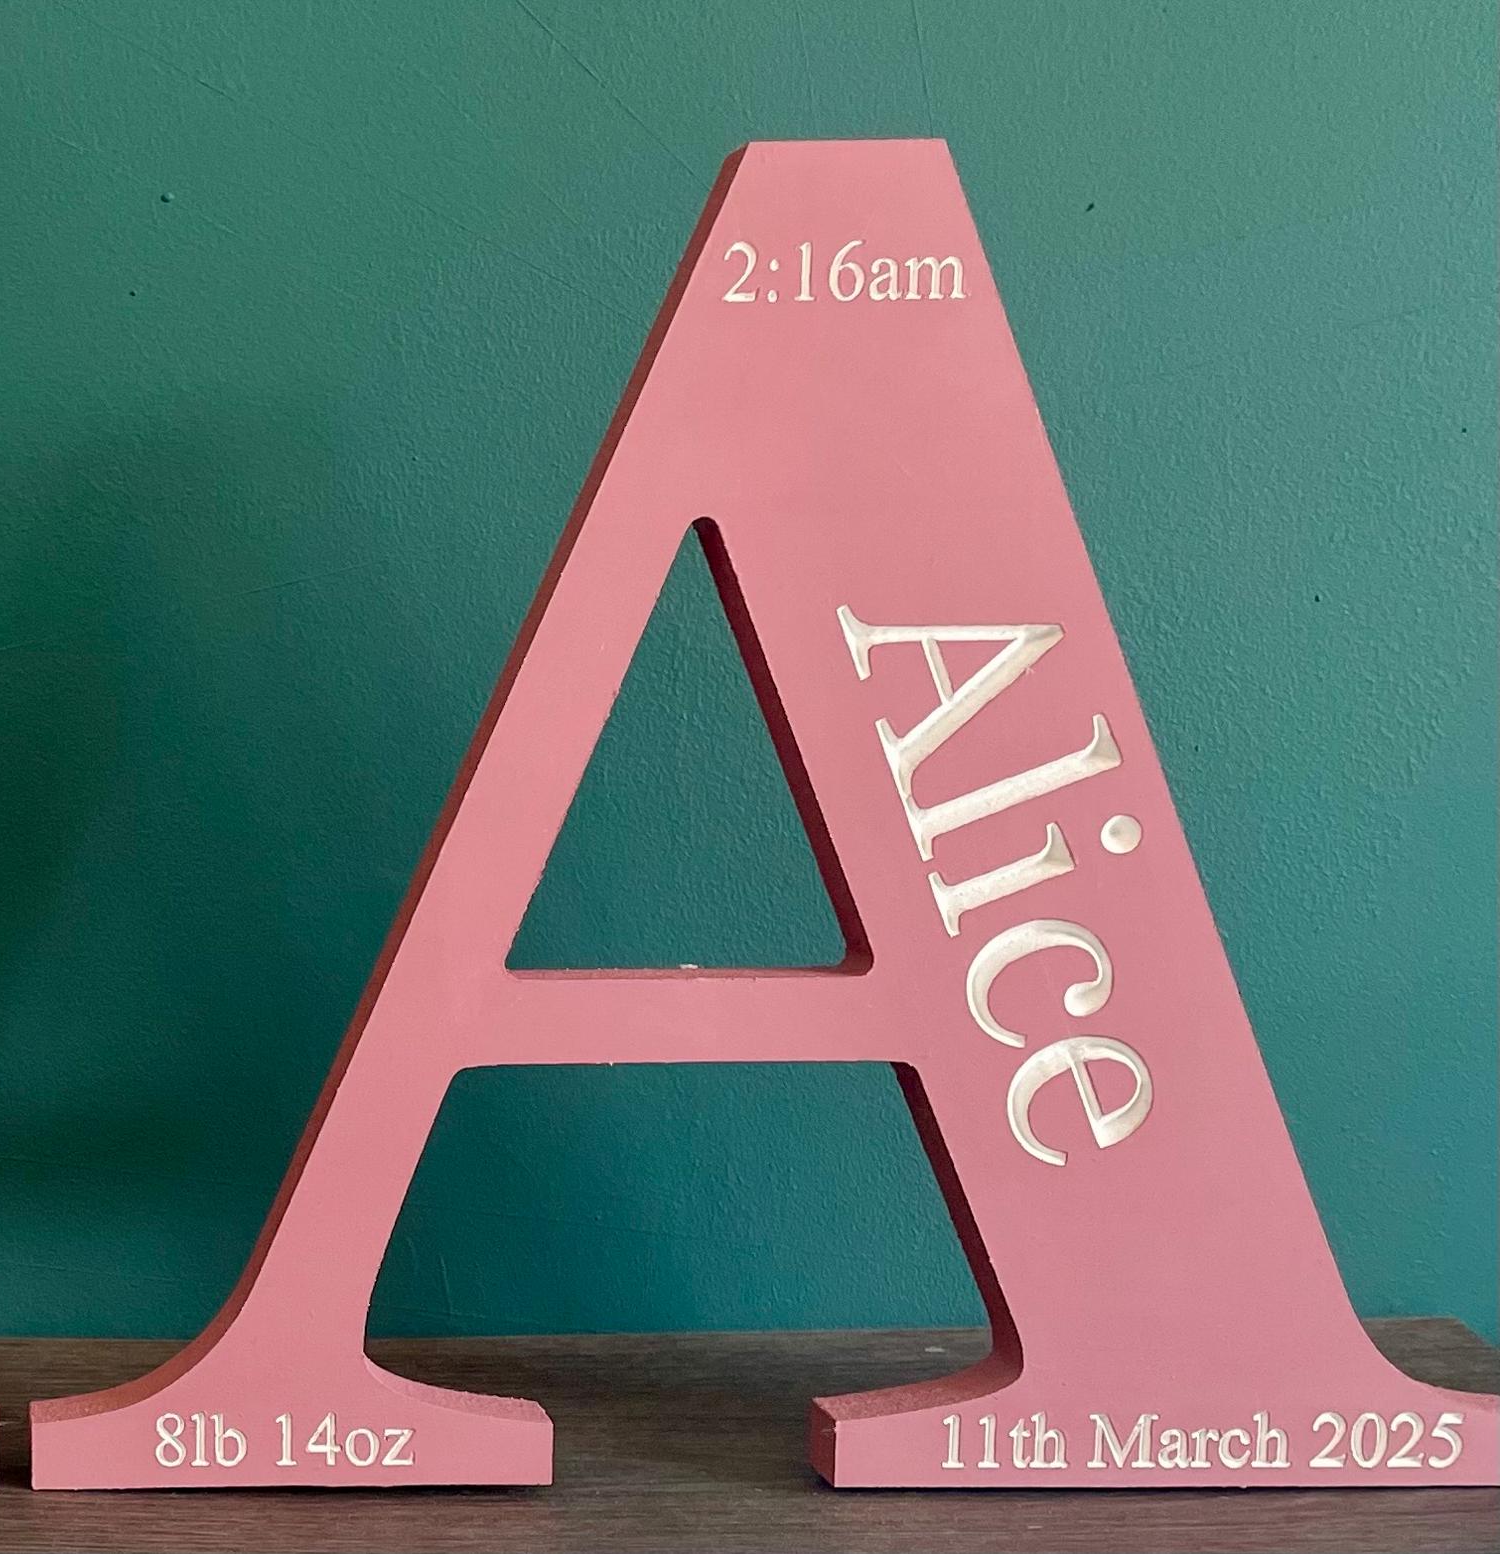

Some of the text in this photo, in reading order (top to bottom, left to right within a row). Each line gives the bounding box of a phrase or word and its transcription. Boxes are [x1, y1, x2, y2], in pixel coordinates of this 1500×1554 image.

[722, 239, 967, 305] 2:16am
[834, 602, 1154, 1168] Alice
[153, 1411, 416, 1468] 8lb 14oz
[938, 1406, 1467, 1474] 11th March 2025
